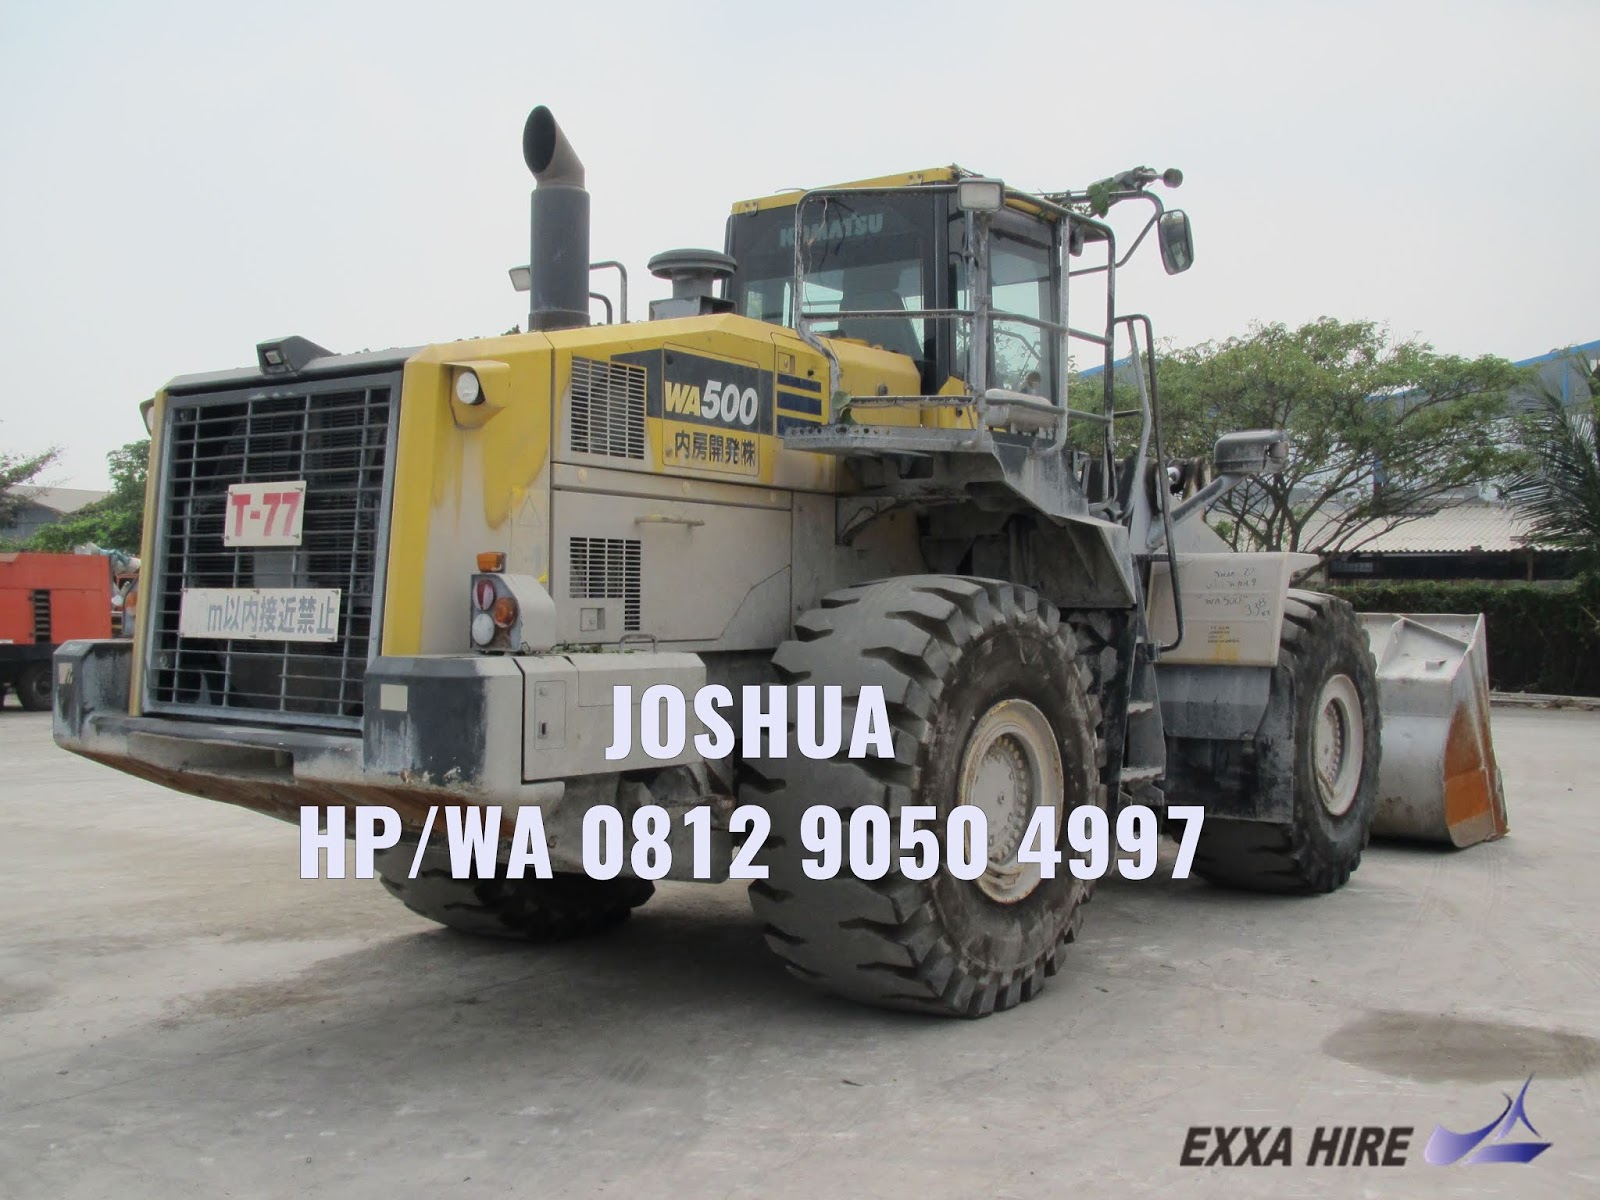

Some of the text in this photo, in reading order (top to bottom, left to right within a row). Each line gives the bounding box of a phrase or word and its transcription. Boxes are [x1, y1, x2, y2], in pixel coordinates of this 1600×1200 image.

[664, 379, 758, 425] WA500
[231, 491, 301, 537] T-77
[207, 595, 335, 634] m以内接近禁止
